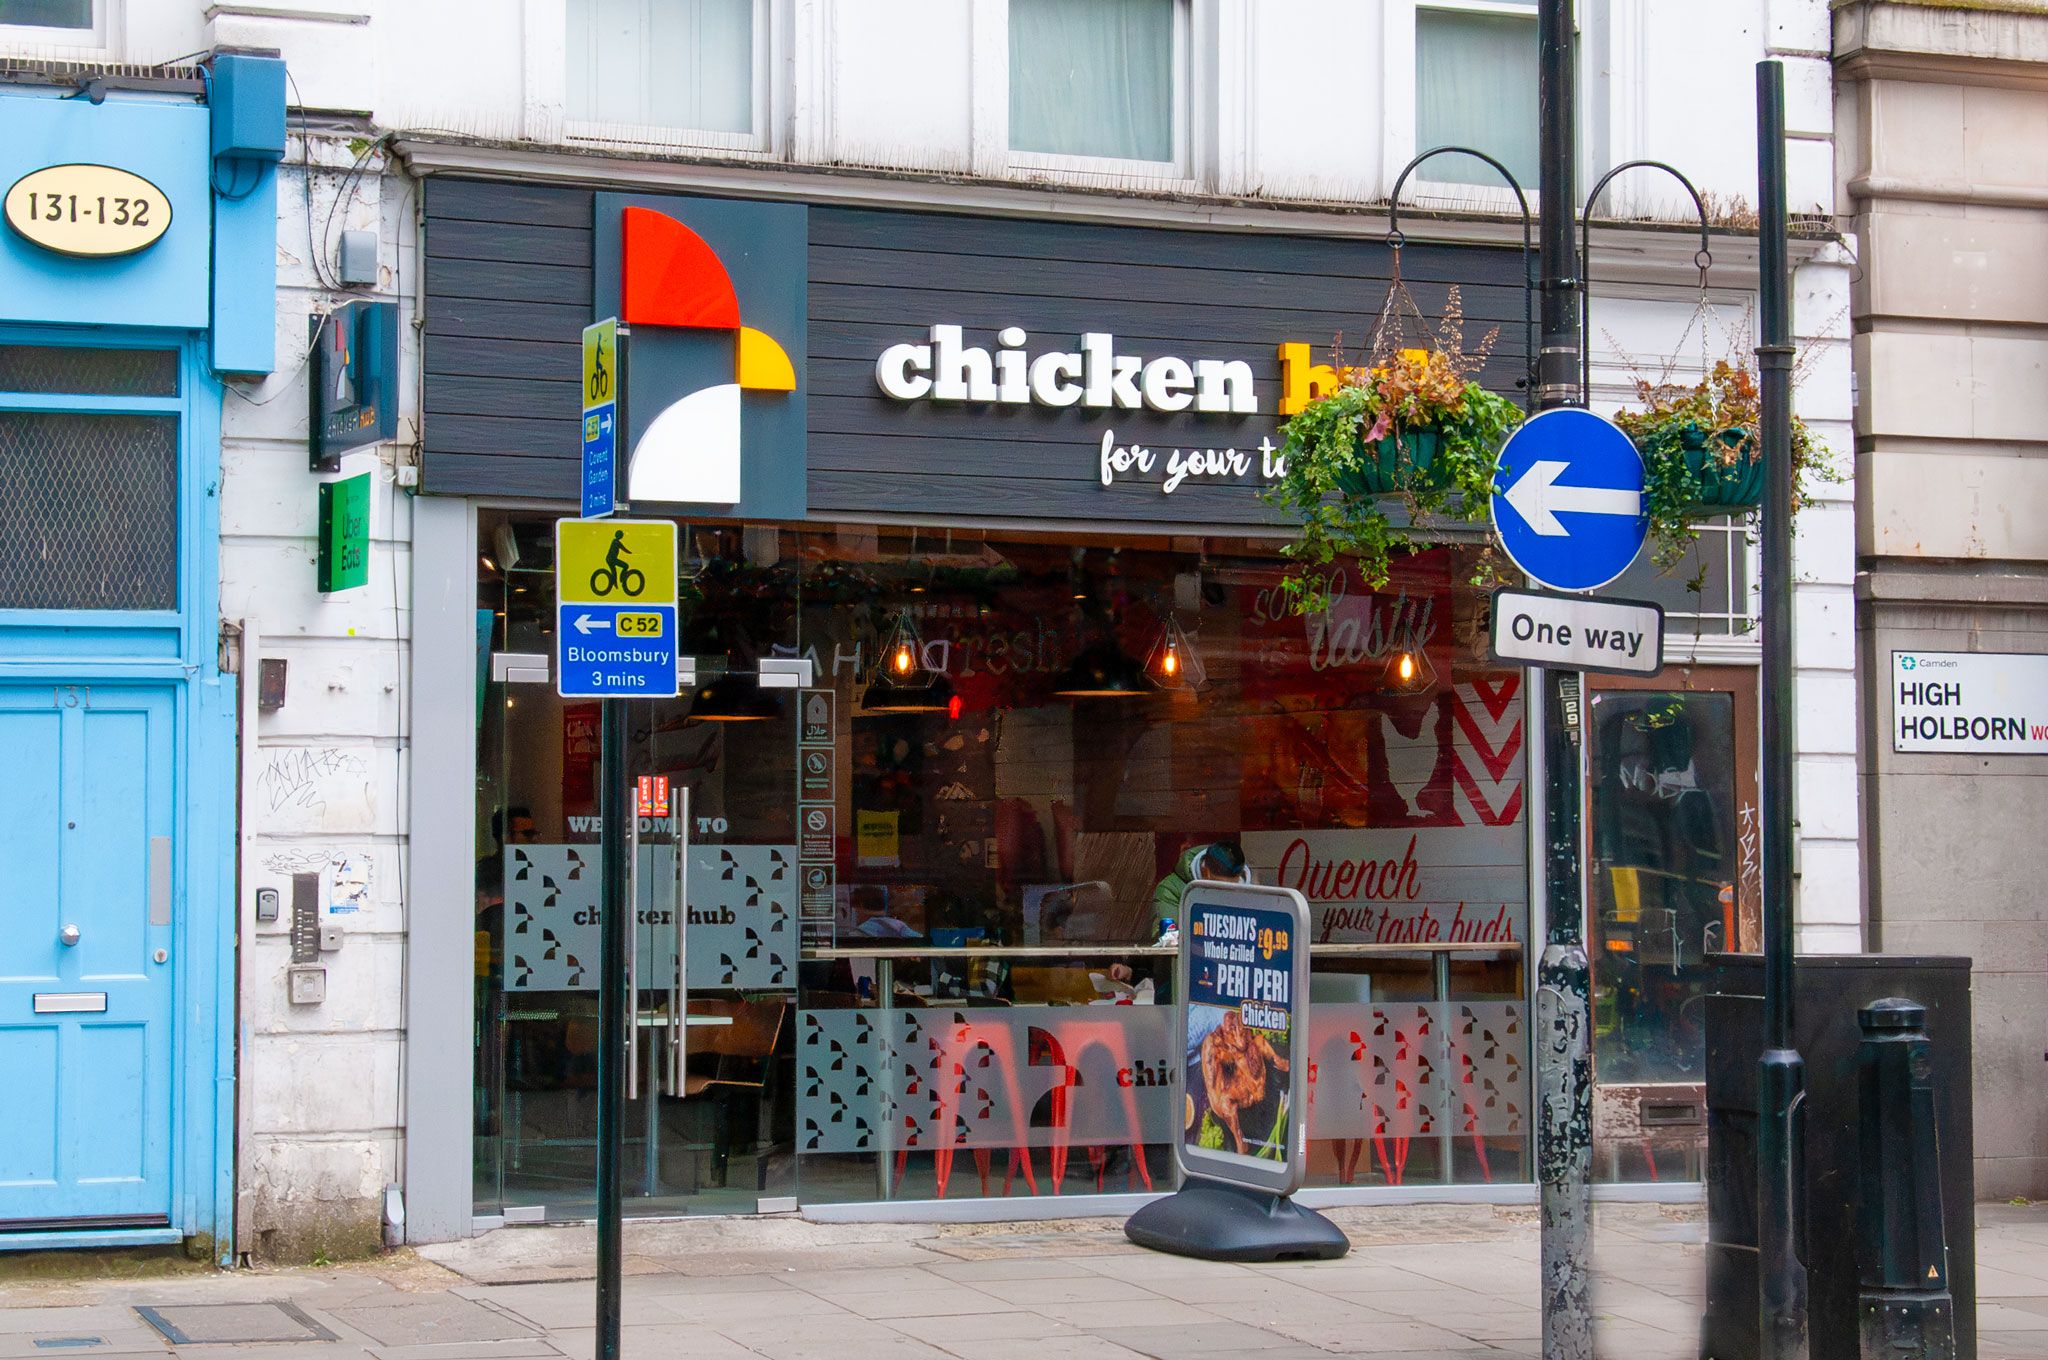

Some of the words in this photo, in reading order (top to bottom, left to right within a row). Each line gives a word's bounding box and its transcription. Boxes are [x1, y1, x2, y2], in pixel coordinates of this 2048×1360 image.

[29, 193, 149, 226] 131-132
[876, 324, 1258, 413] chicken
[1100, 429, 1156, 486] for
[1163, 448, 1251, 494] your
[342, 513, 361, 540] Uber
[341, 544, 361, 571] Eats
[1511, 613, 1572, 646] One
[1585, 628, 1643, 658] way
[568, 647, 669, 666] Bloomsbury
[1919, 658, 1958, 668] Camden
[592, 671, 602, 686] 3
[607, 671, 646, 687] mins
[1900, 682, 1961, 706] HIGH
[1901, 716, 2026, 741] HOLBORN
[697, 817, 728, 833] TO
[1277, 833, 1422, 900] Quench
[687, 905, 737, 925] hub
[1193, 921, 1203, 936] on
[1202, 912, 1257, 942] TUESDAYS
[1319, 906, 1375, 943] your
[1376, 906, 1441, 943] taste
[1203, 941, 1228, 960] Whole
[1229, 944, 1256, 963] Grilled
[1257, 927, 1289, 960] £9.99
[1216, 963, 1249, 999] PERI
[1252, 967, 1289, 1003] PERI
[1241, 1003, 1286, 1030] Chicken
